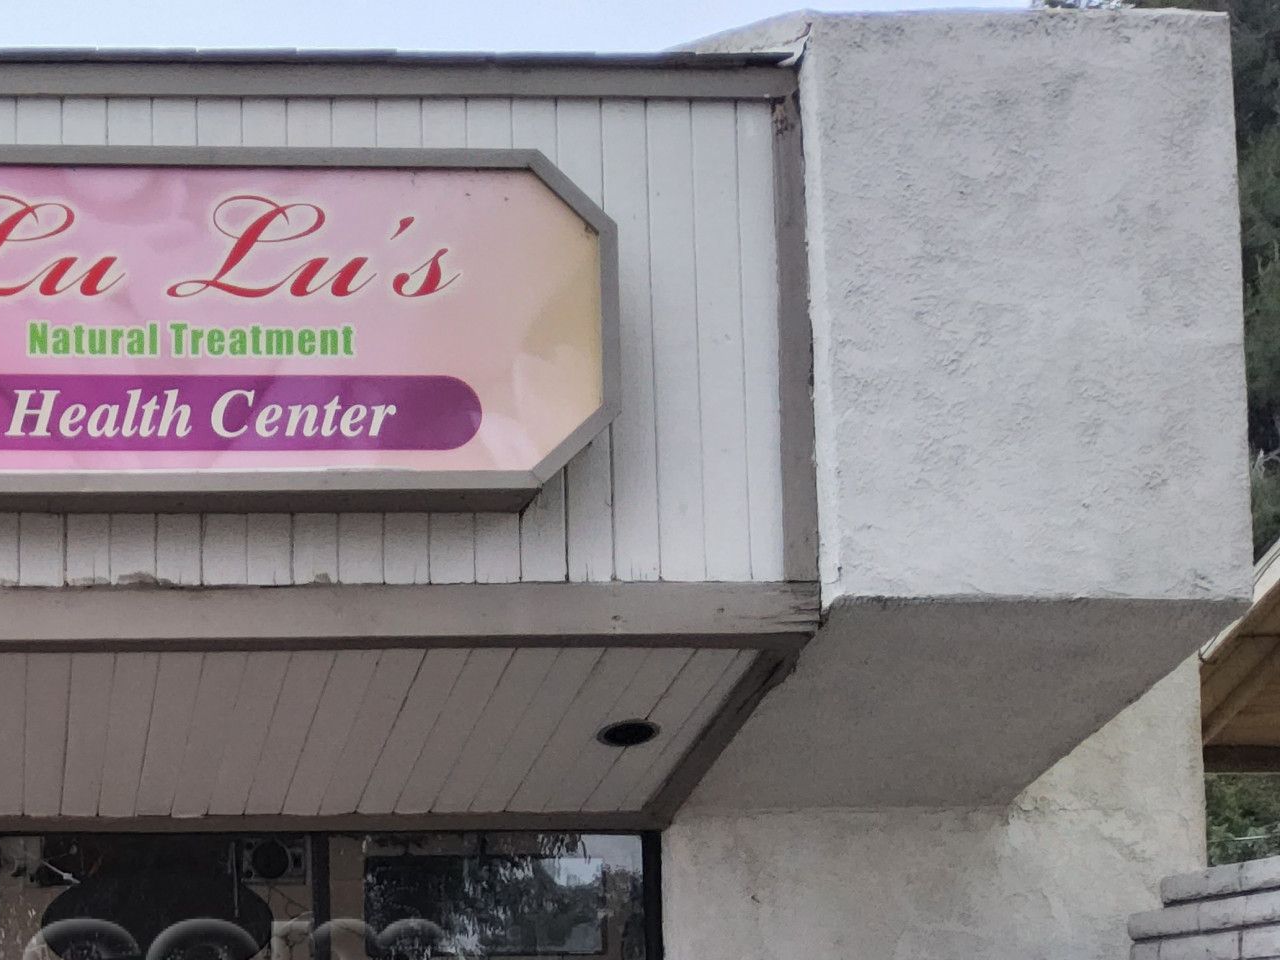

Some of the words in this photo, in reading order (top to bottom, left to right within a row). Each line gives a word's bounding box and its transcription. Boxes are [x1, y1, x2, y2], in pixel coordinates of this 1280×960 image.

[167, 194, 461, 297] Lu's
[28, 321, 158, 356] Natural
[170, 321, 354, 356] Treatment
[4, 388, 192, 438] Health
[211, 388, 397, 438] Center
